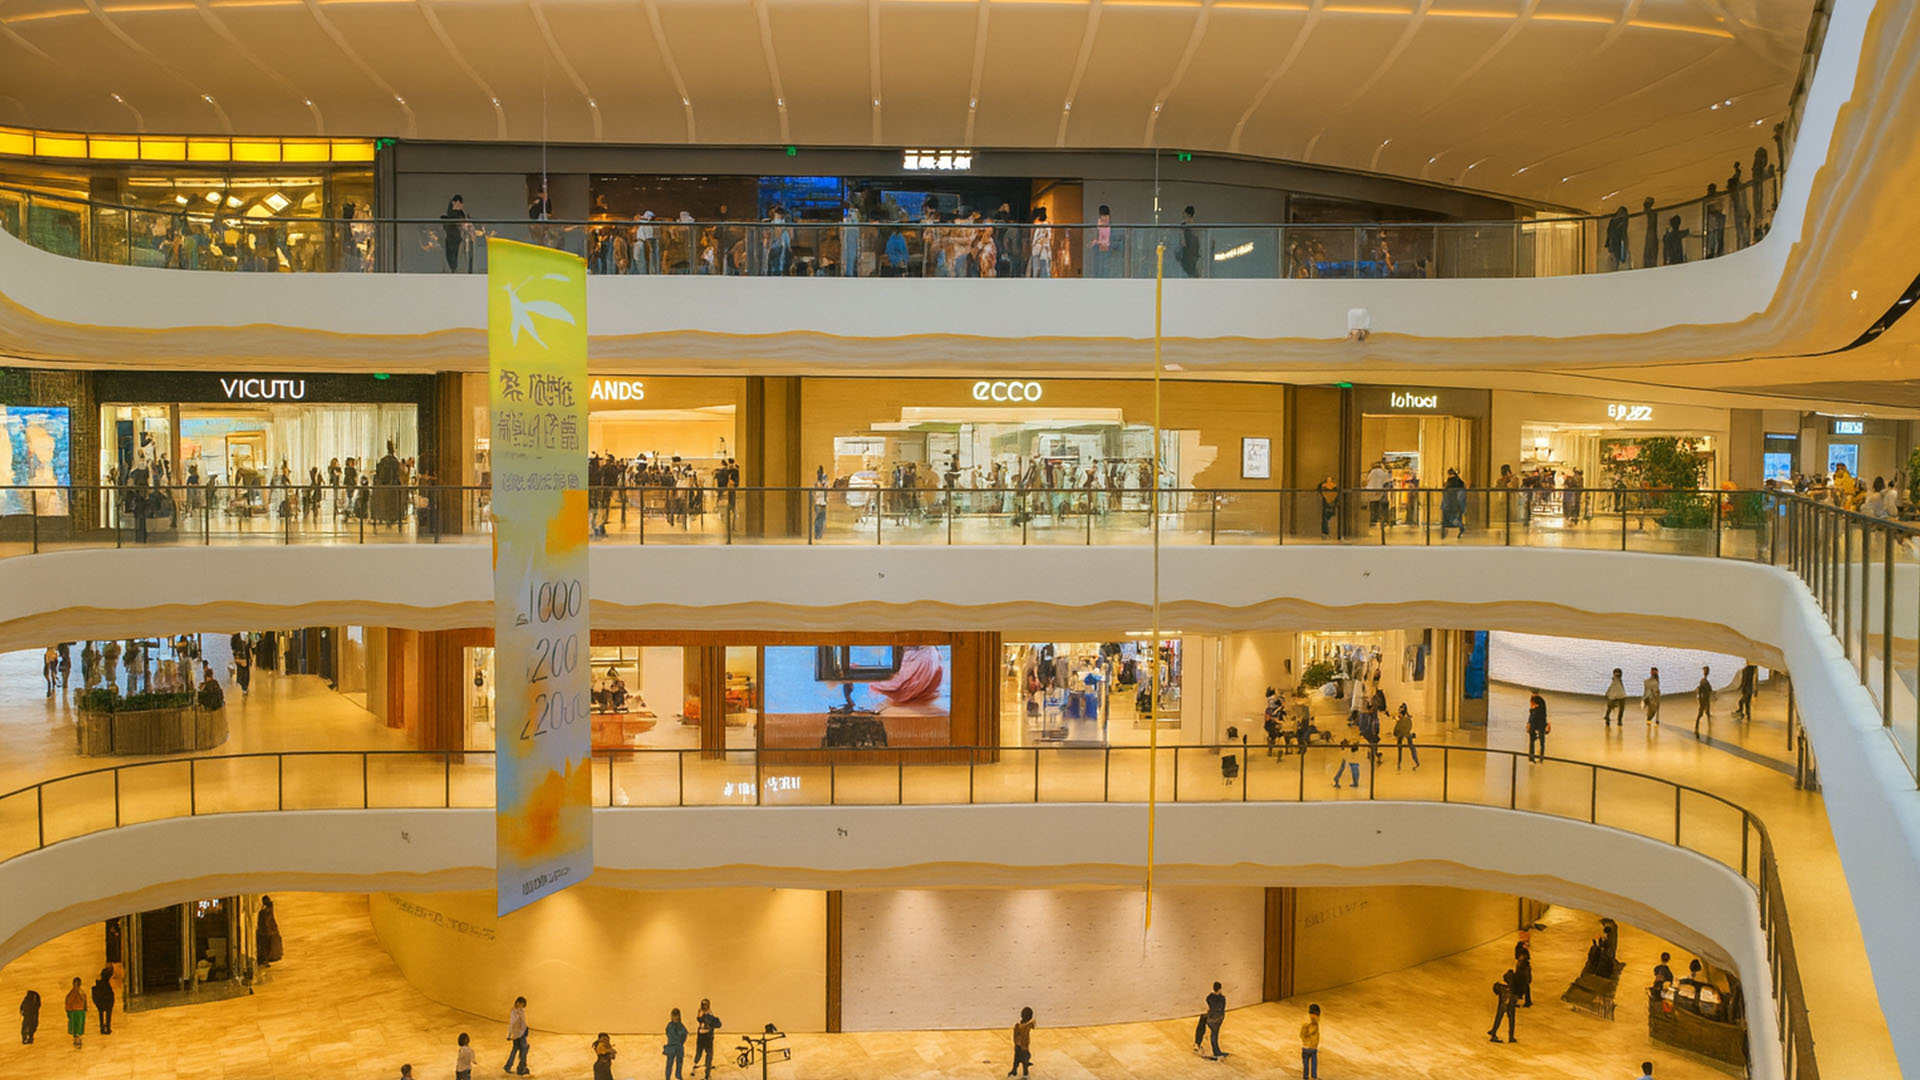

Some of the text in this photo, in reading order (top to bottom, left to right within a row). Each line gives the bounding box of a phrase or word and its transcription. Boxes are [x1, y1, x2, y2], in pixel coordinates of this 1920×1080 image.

[220, 378, 305, 399] VICUTU
[590, 379, 644, 400] ANDS
[972, 381, 1042, 402] ecco
